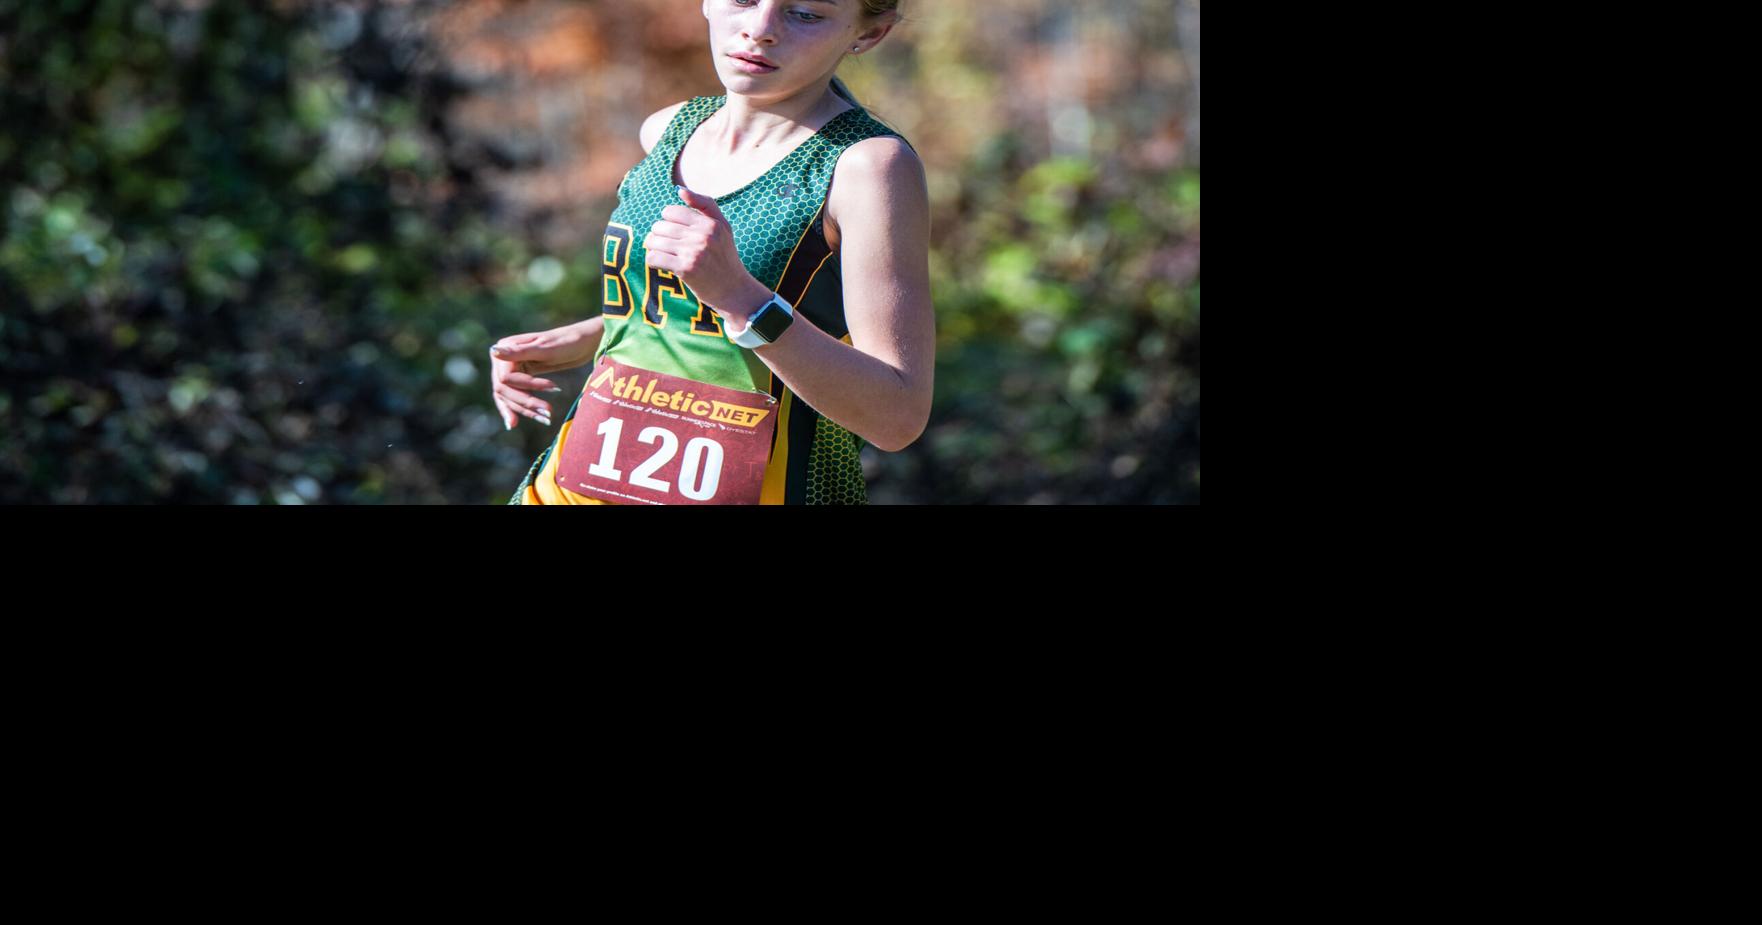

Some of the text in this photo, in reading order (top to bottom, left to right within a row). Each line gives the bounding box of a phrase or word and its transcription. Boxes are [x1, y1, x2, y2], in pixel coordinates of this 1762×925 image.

[590, 366, 760, 424] Athletic NET
[588, 416, 724, 501] 120
